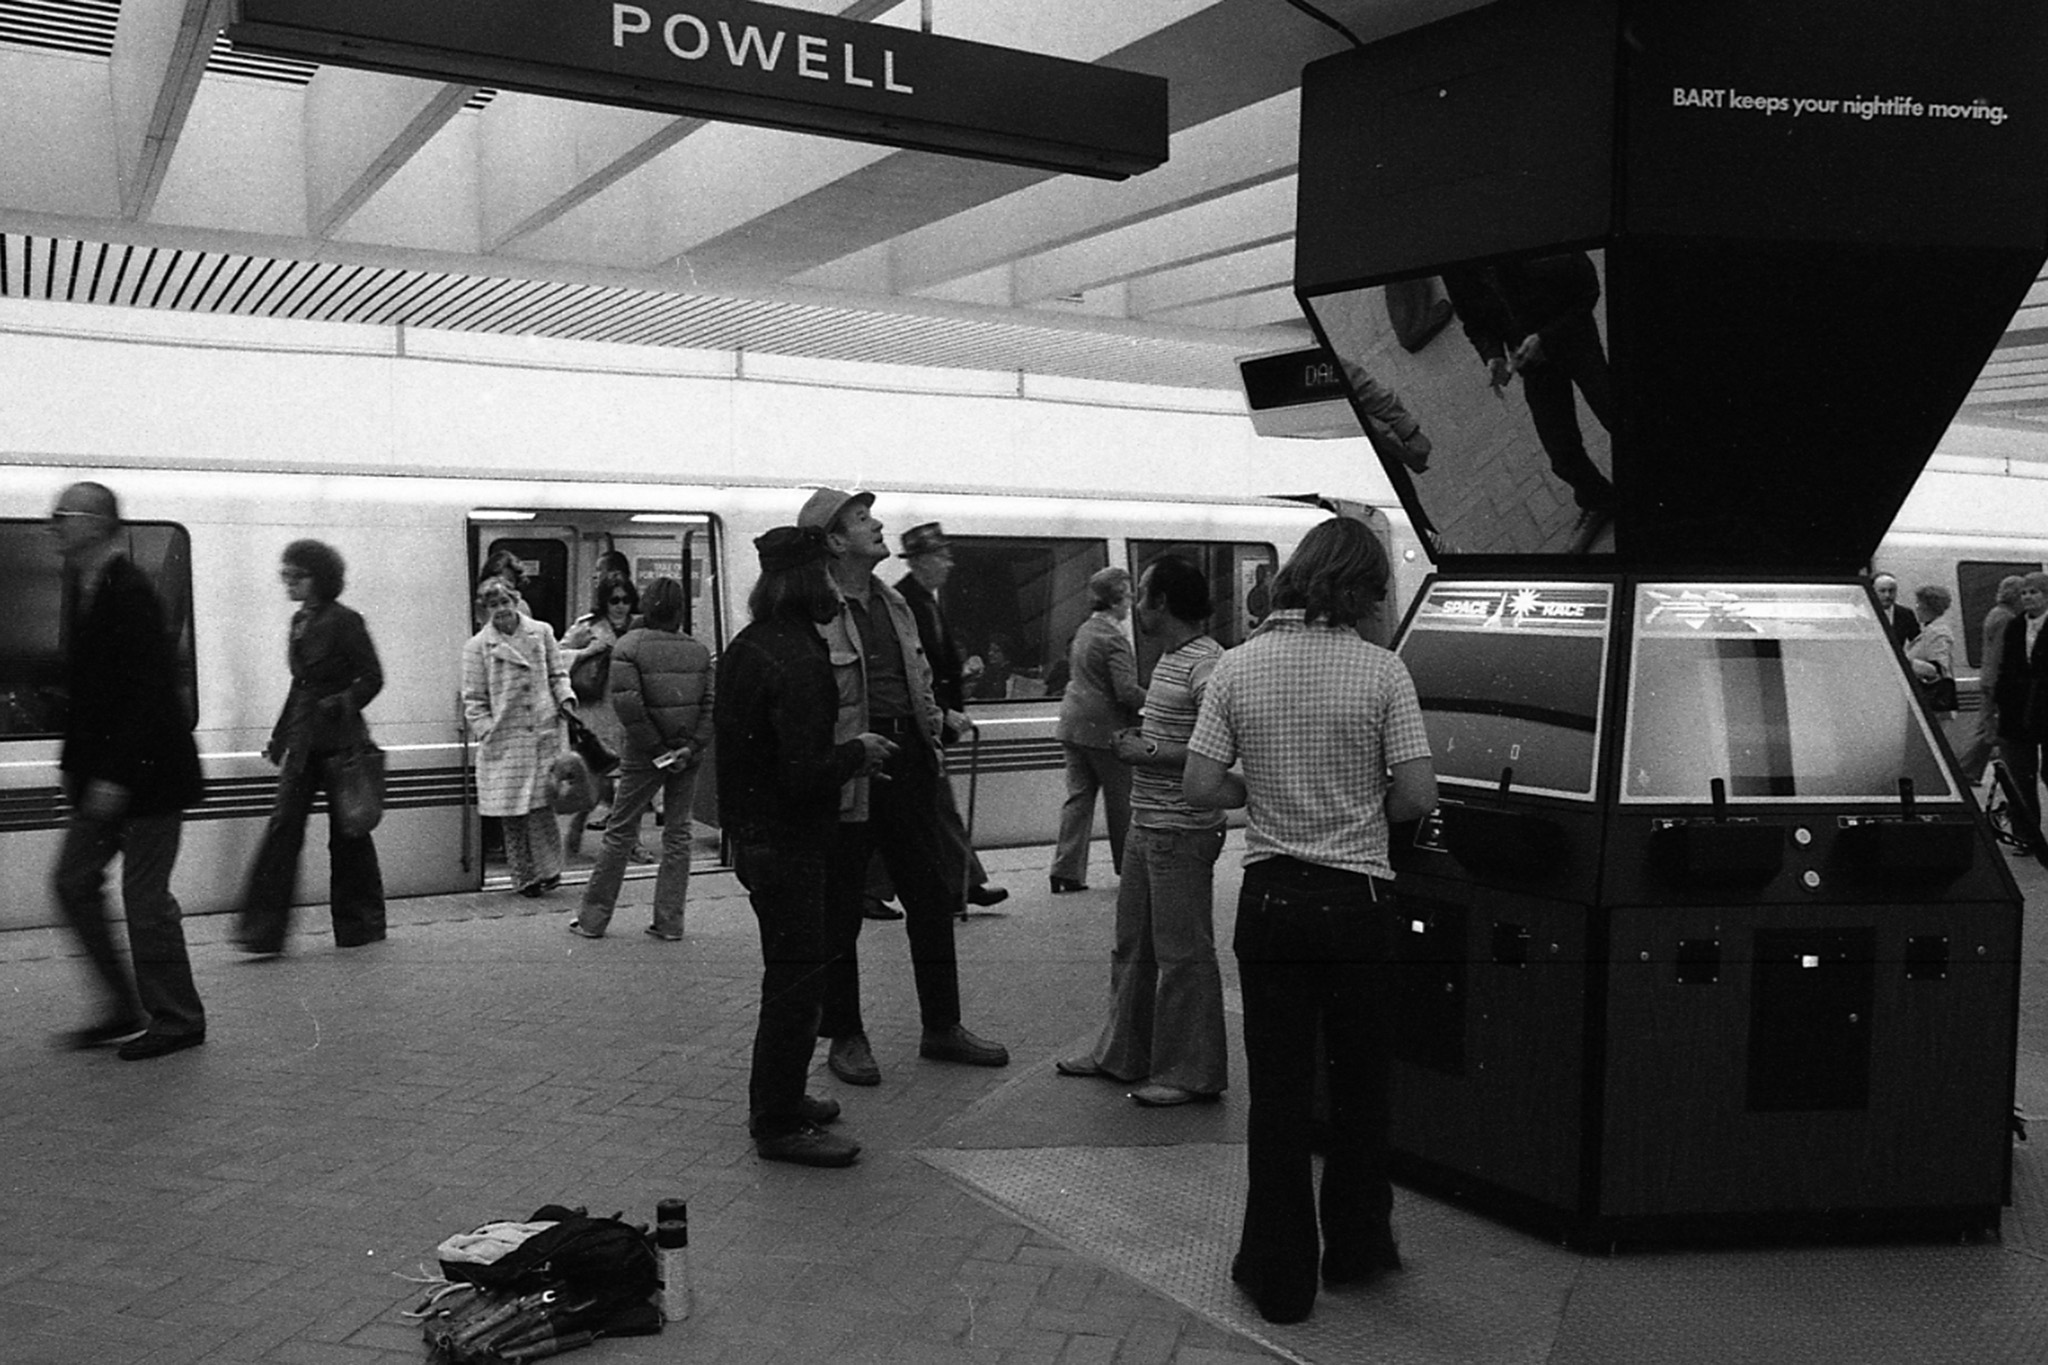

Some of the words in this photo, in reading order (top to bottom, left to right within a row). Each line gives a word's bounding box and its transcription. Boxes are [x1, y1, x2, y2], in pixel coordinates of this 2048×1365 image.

[613, 3, 914, 94] POWELL
[1672, 87, 1725, 108] BART
[1729, 88, 1789, 116] keeps
[1793, 97, 1839, 117] your
[1843, 94, 1924, 120] nightlife
[1928, 98, 2008, 125] moving.
[1442, 600, 1490, 614] SPACE
[1542, 604, 1586, 617] RACE
